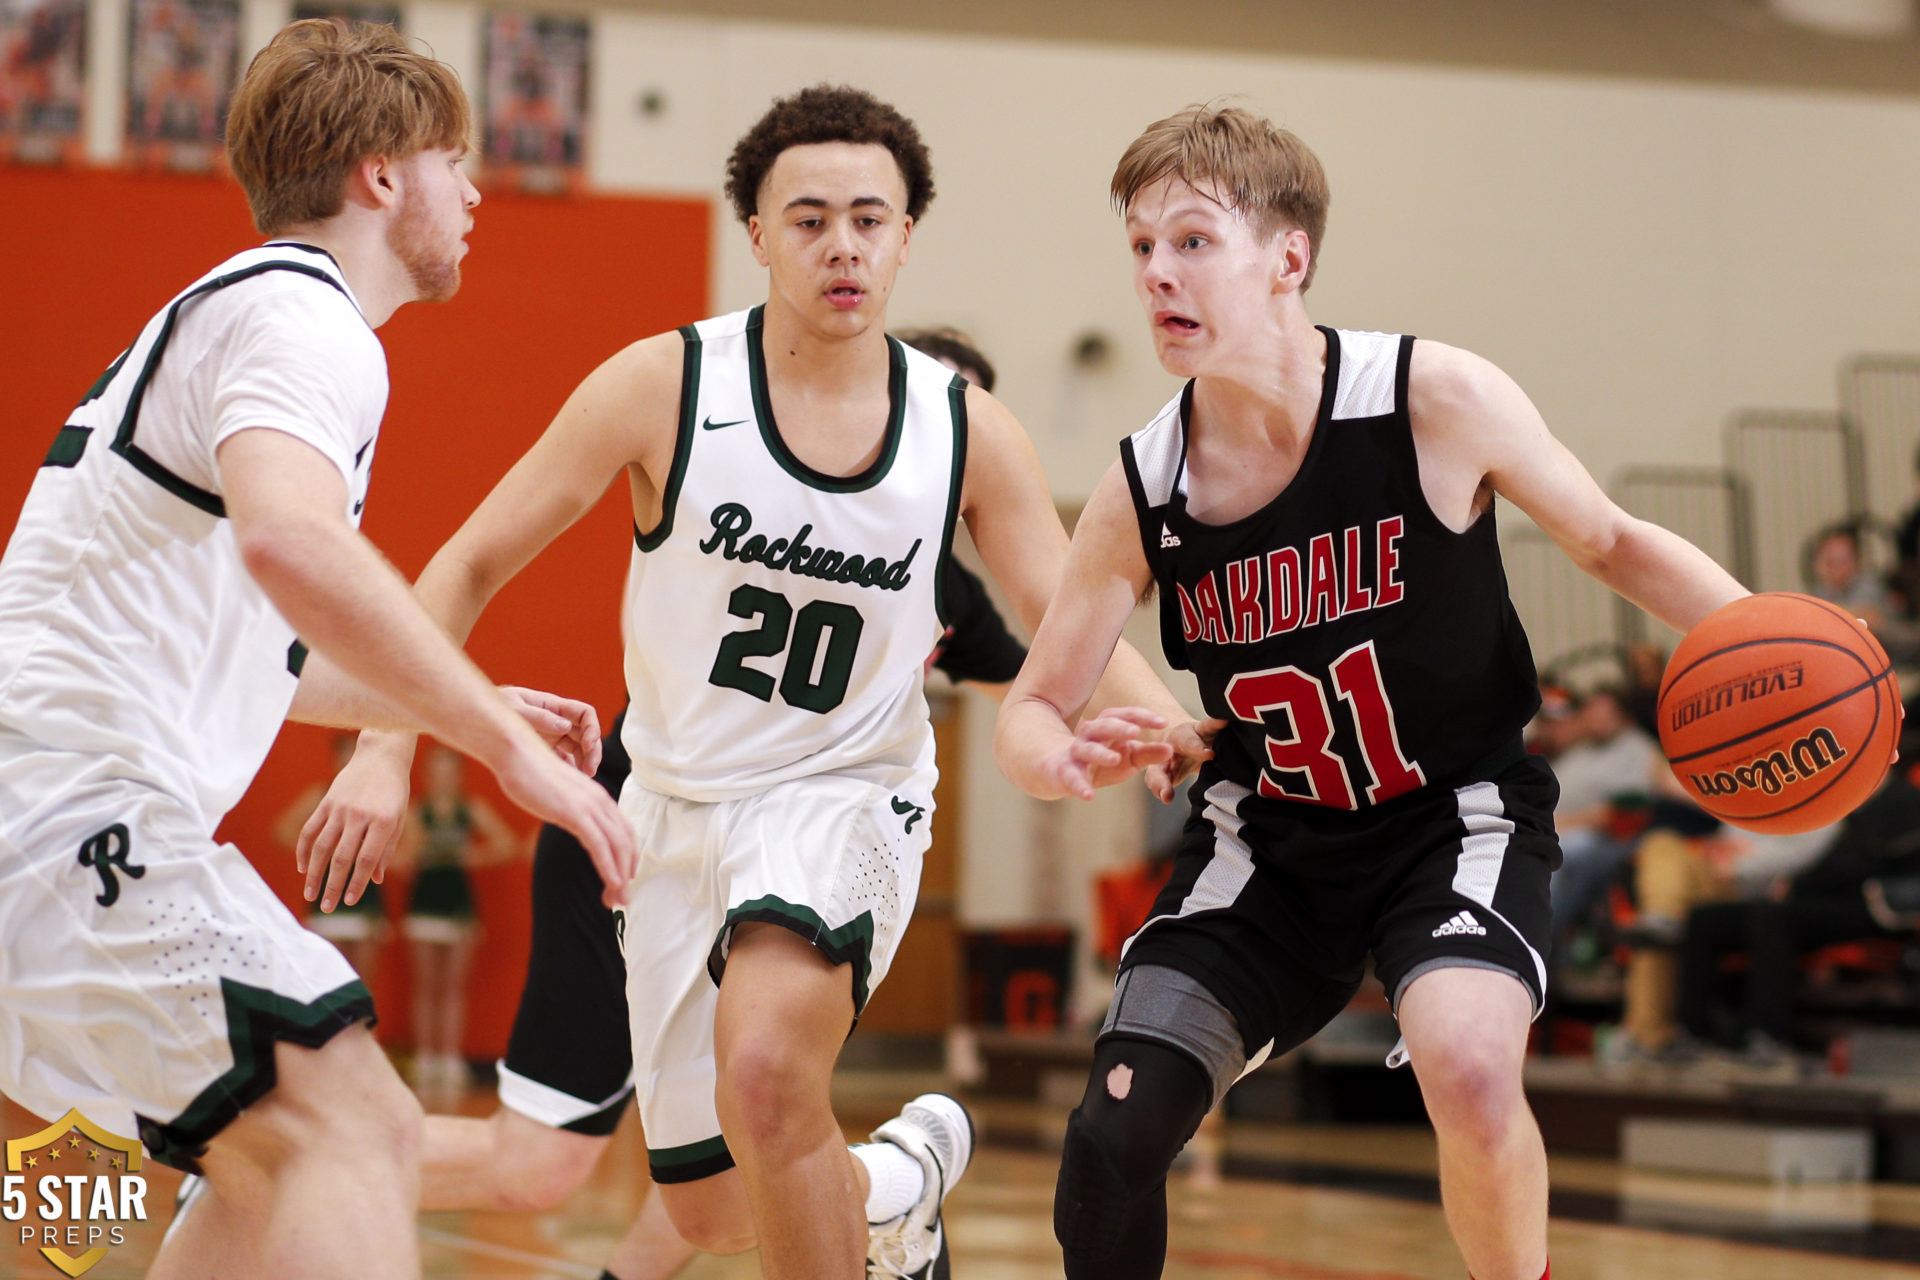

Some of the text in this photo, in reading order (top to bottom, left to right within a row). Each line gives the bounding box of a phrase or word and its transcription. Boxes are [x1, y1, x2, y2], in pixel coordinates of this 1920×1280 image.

[699, 502, 923, 591] Rockwood
[708, 583, 865, 715] 20
[1223, 639, 1428, 812] 31
[1671, 667, 1804, 733] EVOLUTION
[1687, 726, 1848, 797] Wilson
[1431, 924, 1487, 938] adidas
